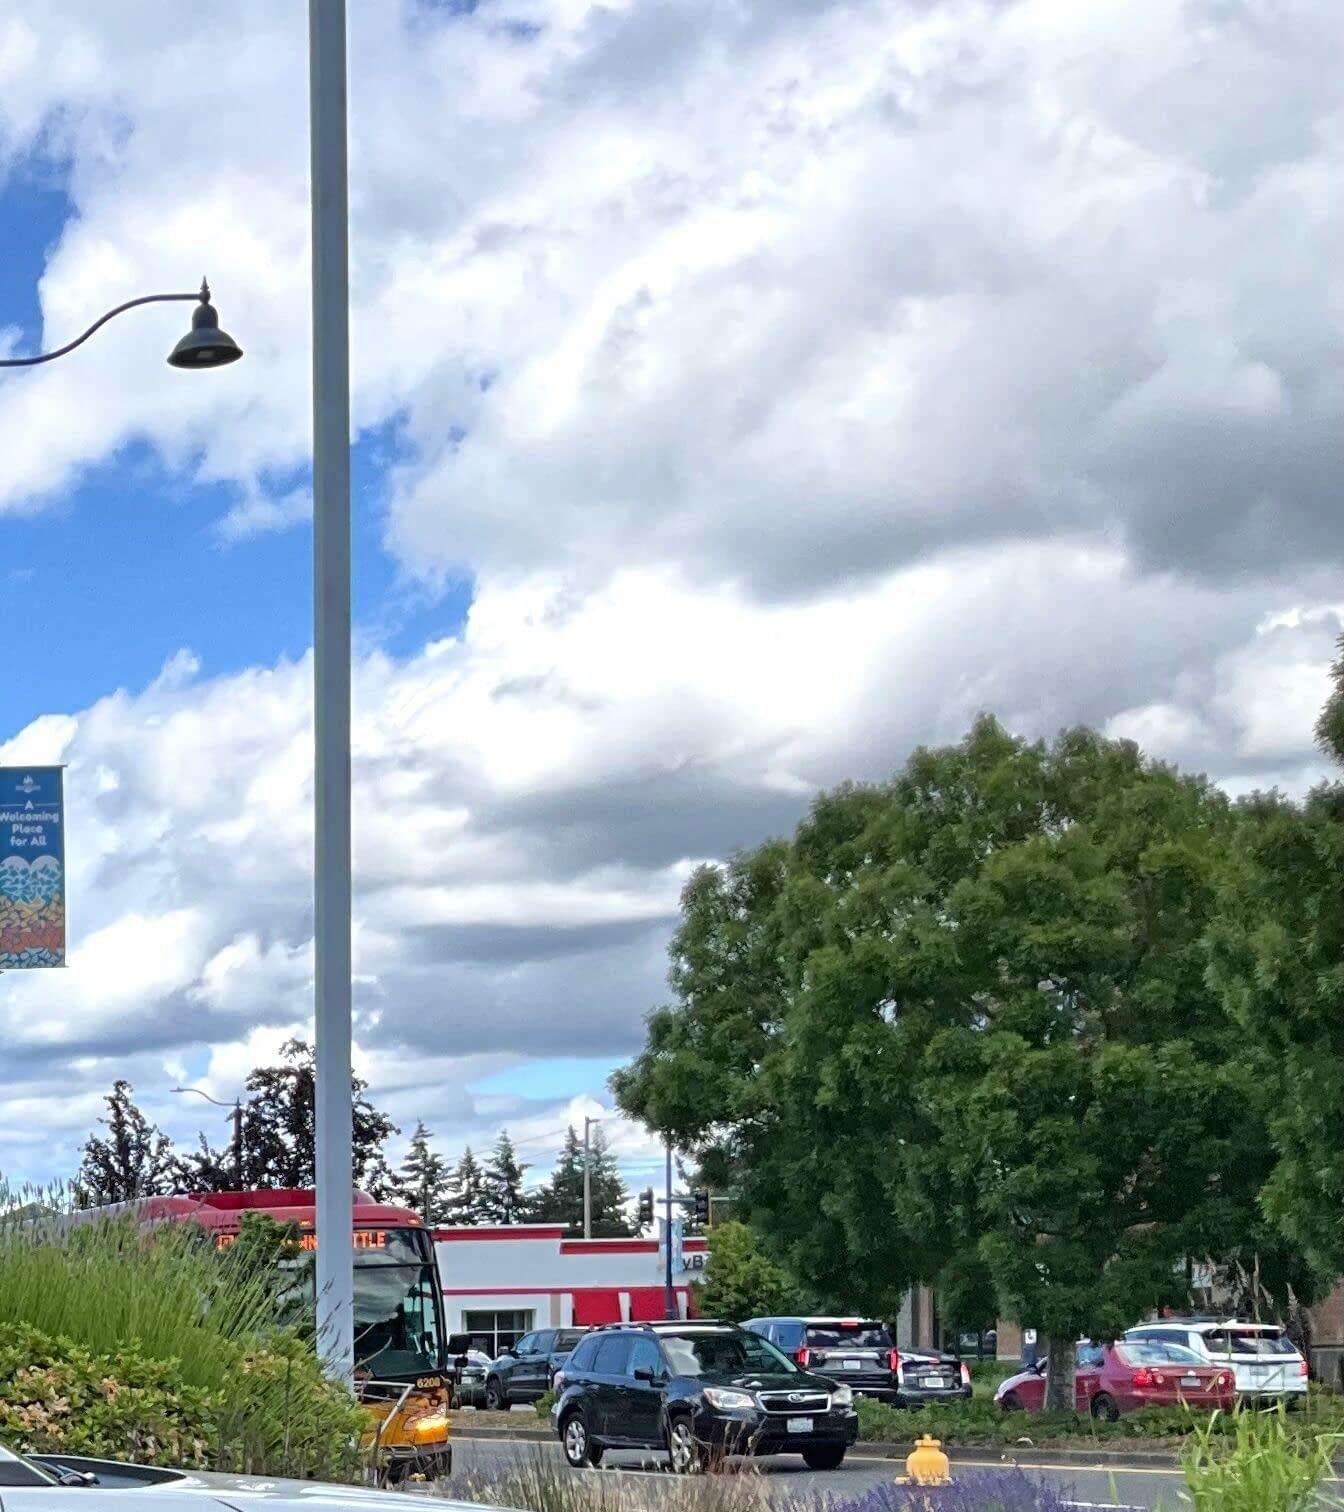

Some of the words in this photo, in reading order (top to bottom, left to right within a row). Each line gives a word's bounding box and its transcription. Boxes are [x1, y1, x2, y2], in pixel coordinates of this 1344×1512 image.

[24, 800, 34, 810] A
[12, 823, 43, 834] Place
[10, 835, 28, 846] for
[30, 835, 47, 846] All
